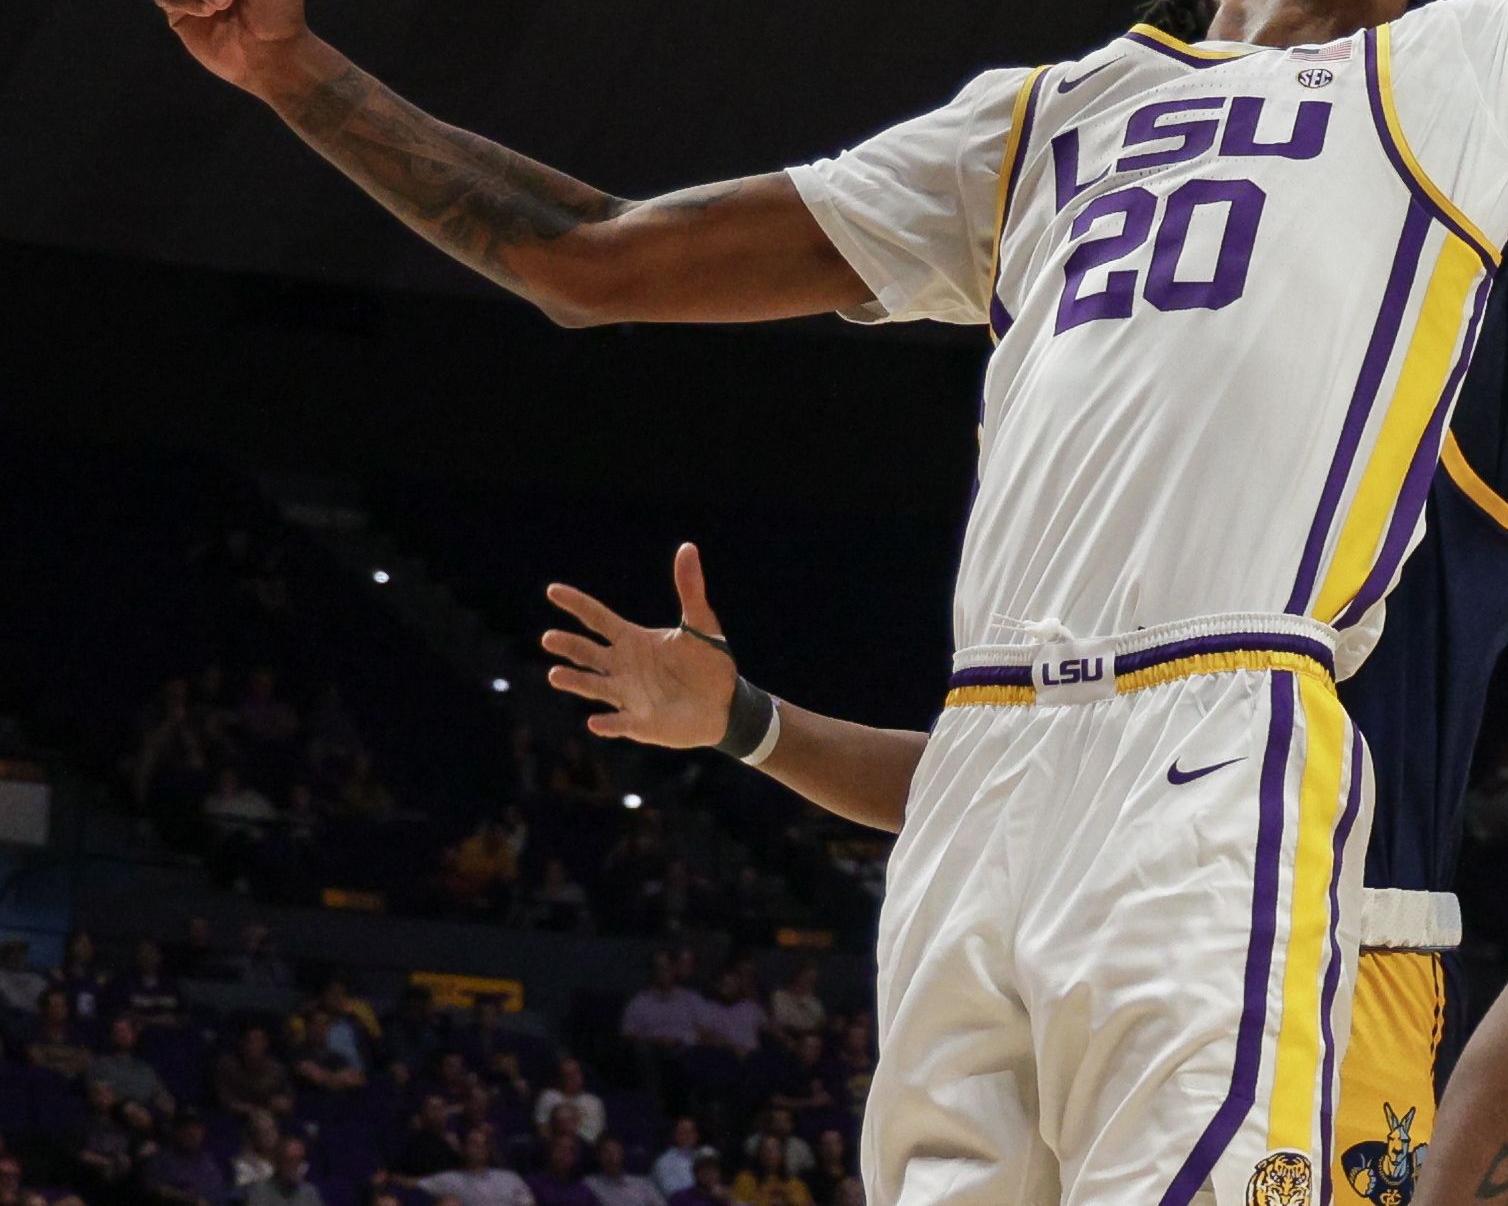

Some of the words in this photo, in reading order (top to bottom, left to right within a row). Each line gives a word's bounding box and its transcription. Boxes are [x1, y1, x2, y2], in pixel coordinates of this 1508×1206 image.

[1299, 68, 1333, 88] SEC
[1051, 96, 1333, 215] LSU
[1053, 179, 1267, 337] 20
[1041, 656, 1104, 687] LSU
